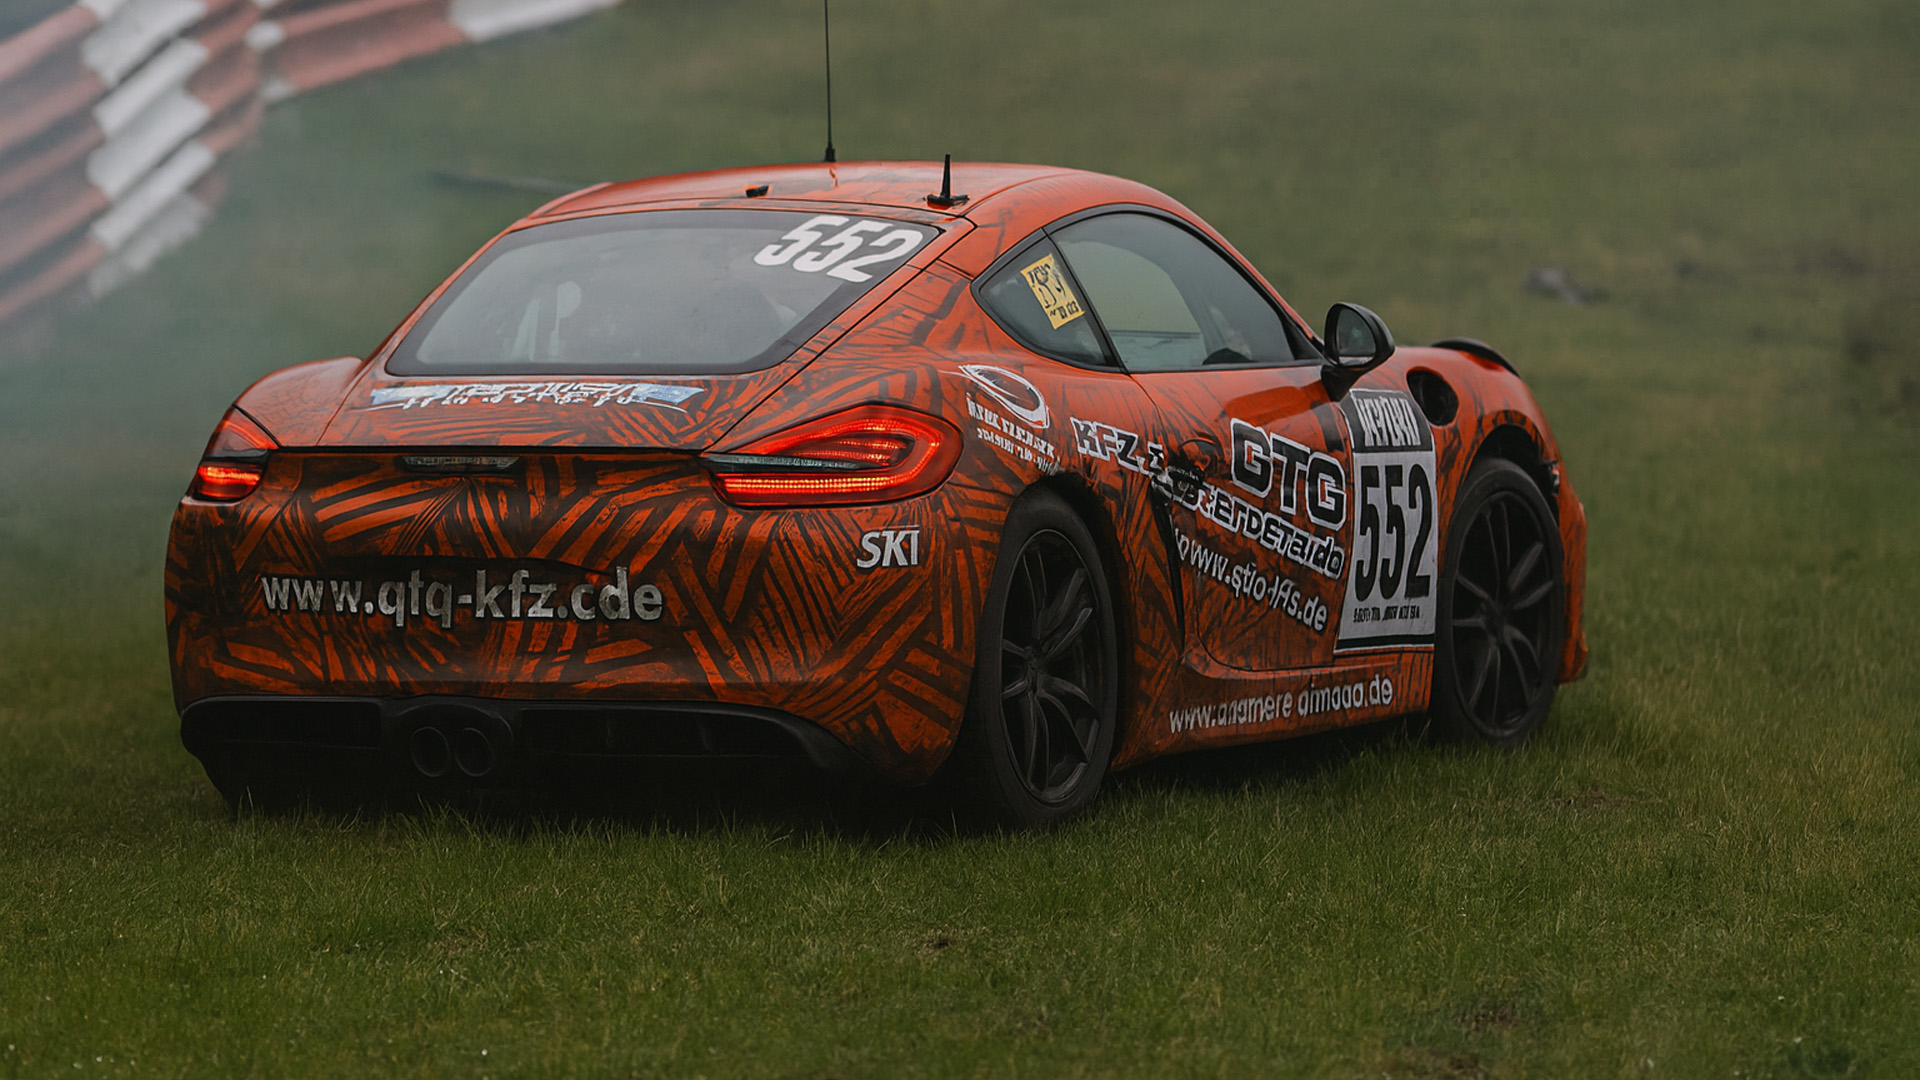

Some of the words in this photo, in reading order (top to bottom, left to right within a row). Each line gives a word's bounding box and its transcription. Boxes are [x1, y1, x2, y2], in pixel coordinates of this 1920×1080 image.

[753, 214, 923, 283] 552
[1230, 417, 1347, 531] GTG
[857, 529, 920, 569] SKI
[1355, 463, 1432, 602] 552
